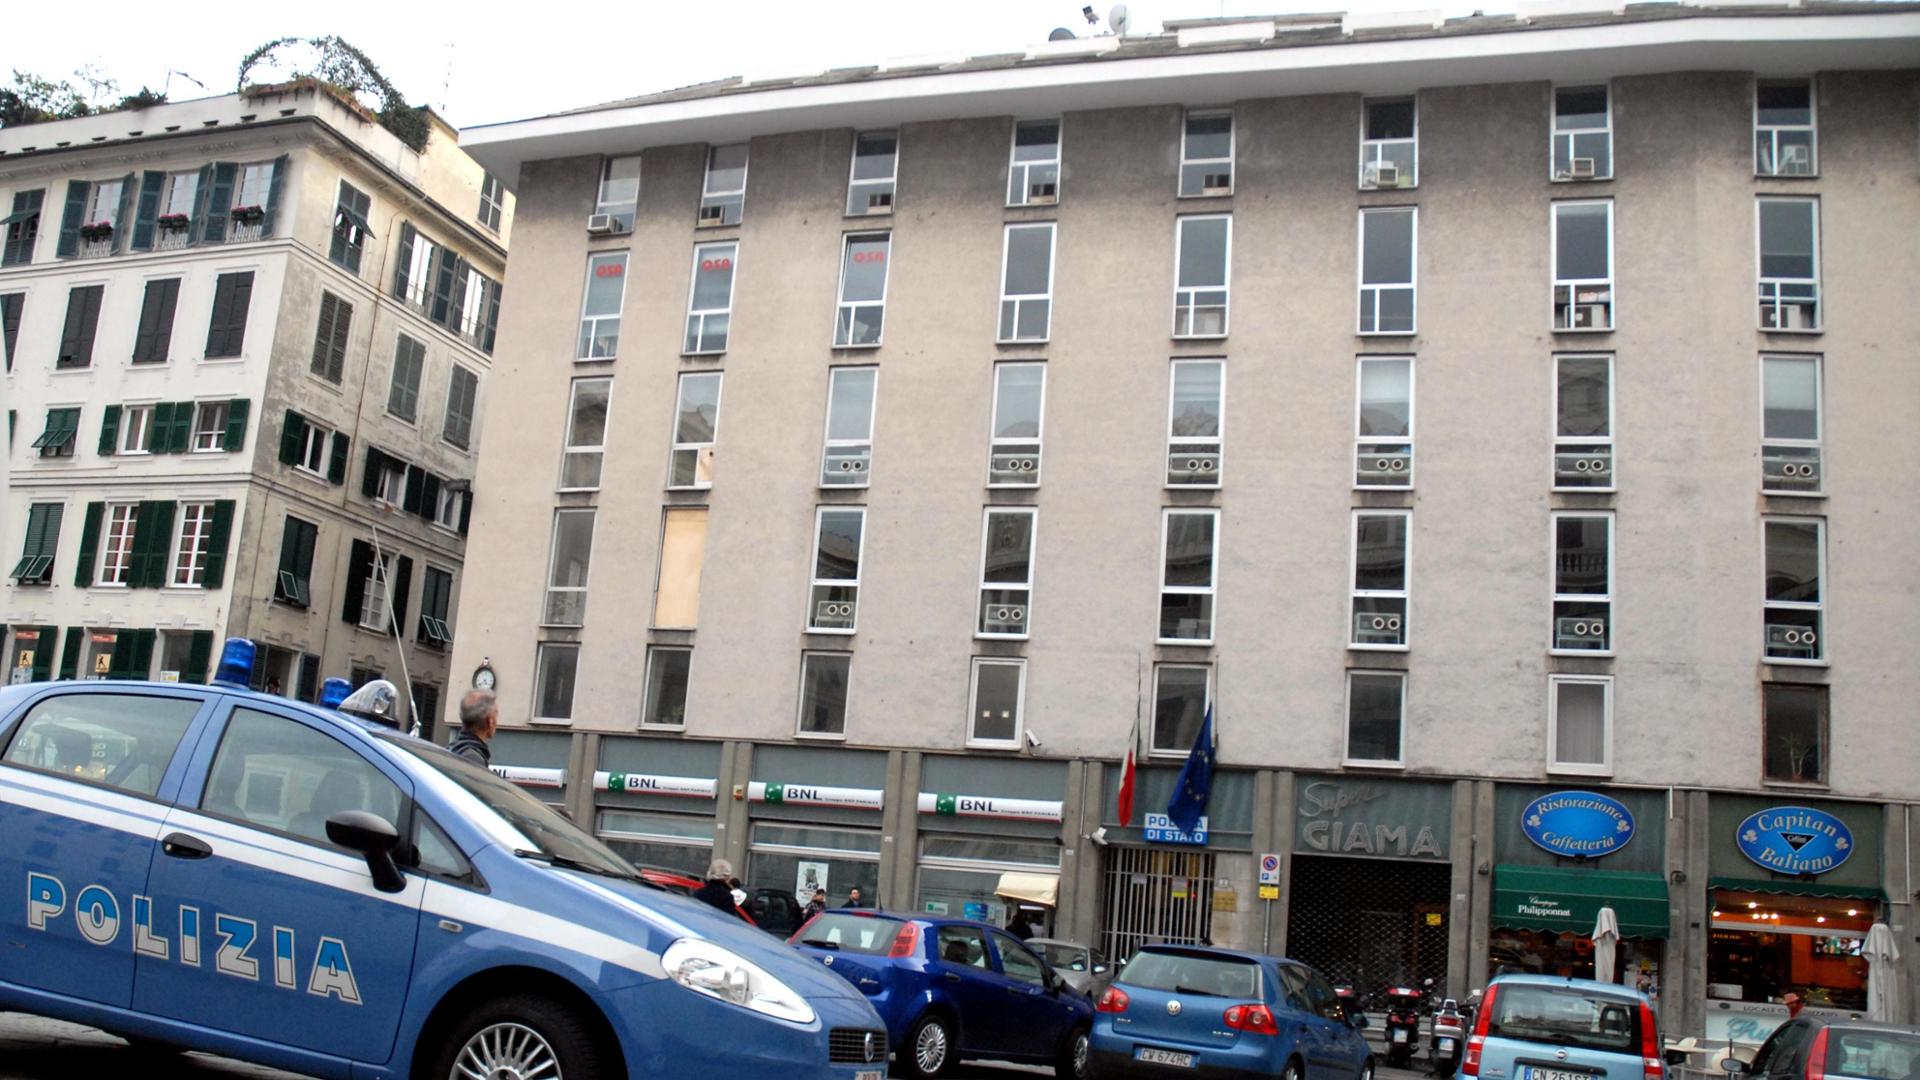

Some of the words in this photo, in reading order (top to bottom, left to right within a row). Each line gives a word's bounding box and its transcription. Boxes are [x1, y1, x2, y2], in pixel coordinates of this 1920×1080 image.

[493, 768, 511, 779] NL
[629, 777, 661, 789] BNL
[787, 788, 822, 800] BNL
[1299, 781, 1390, 818] Super
[960, 799, 998, 812] BNL
[1536, 797, 1624, 821] Ristorazione
[1149, 816, 1203, 829] POLA
[1758, 812, 1837, 837] Capitan
[1147, 829, 1160, 839] DI
[1302, 820, 1442, 858] GIAMA
[1542, 831, 1615, 850] Caffetteria
[1759, 847, 1833, 871] Baliano
[1518, 904, 1571, 916] Philipponnat
[26, 870, 363, 1006] POLIZIA
[1532, 1068, 1547, 1080] CN
